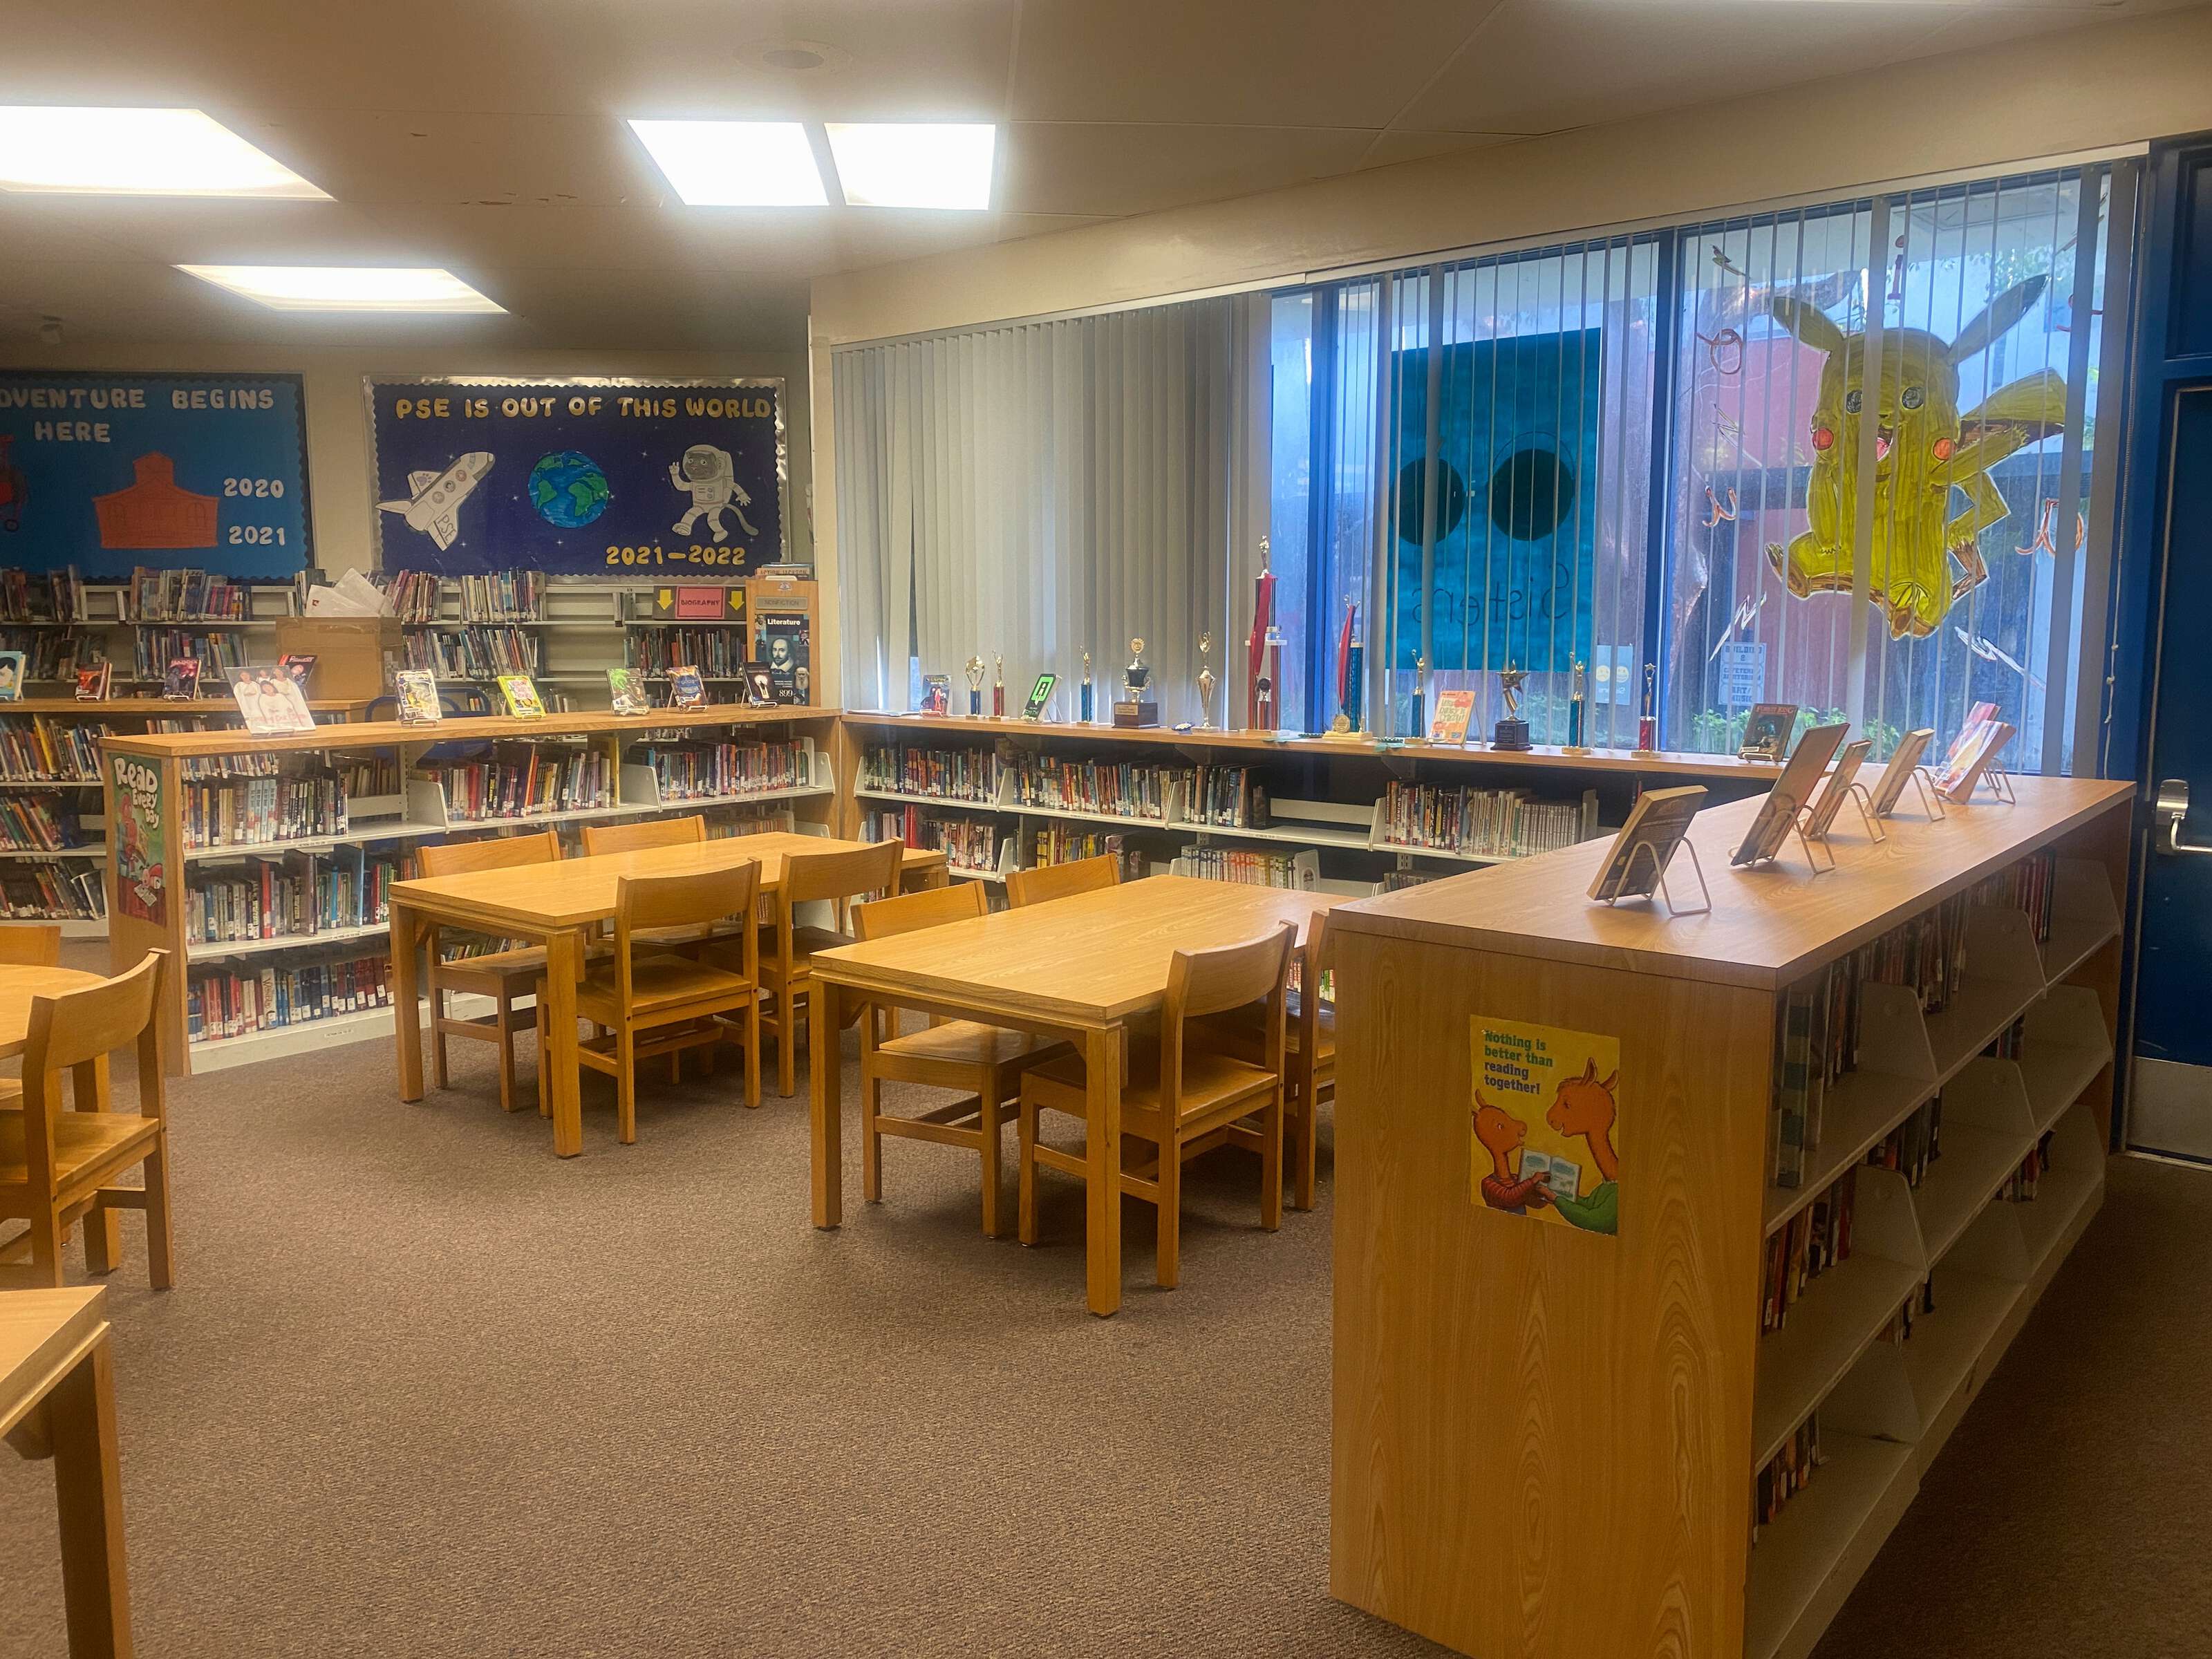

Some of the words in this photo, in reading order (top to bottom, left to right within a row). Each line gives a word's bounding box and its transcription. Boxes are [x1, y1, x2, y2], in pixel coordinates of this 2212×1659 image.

[171, 389, 274, 409] BEGINS
[396, 398, 449, 419] PSE
[465, 398, 489, 418] IS
[501, 397, 555, 418] OUT
[568, 396, 603, 416] OF
[617, 397, 675, 418] THIS
[685, 397, 771, 418] WORLD
[35, 421, 111, 442] HERE
[223, 478, 284, 498] 2020
[229, 526, 285, 545] 2021
[779, 689, 793, 697] 899
[1484, 1030, 1532, 1051] Nothing
[1535, 1039, 1546, 1051] is
[1484, 1045, 1521, 1061] better
[1526, 1053, 1553, 1067] than
[1484, 1062, 1529, 1080] reading
[1484, 1075, 1540, 1094] together!
